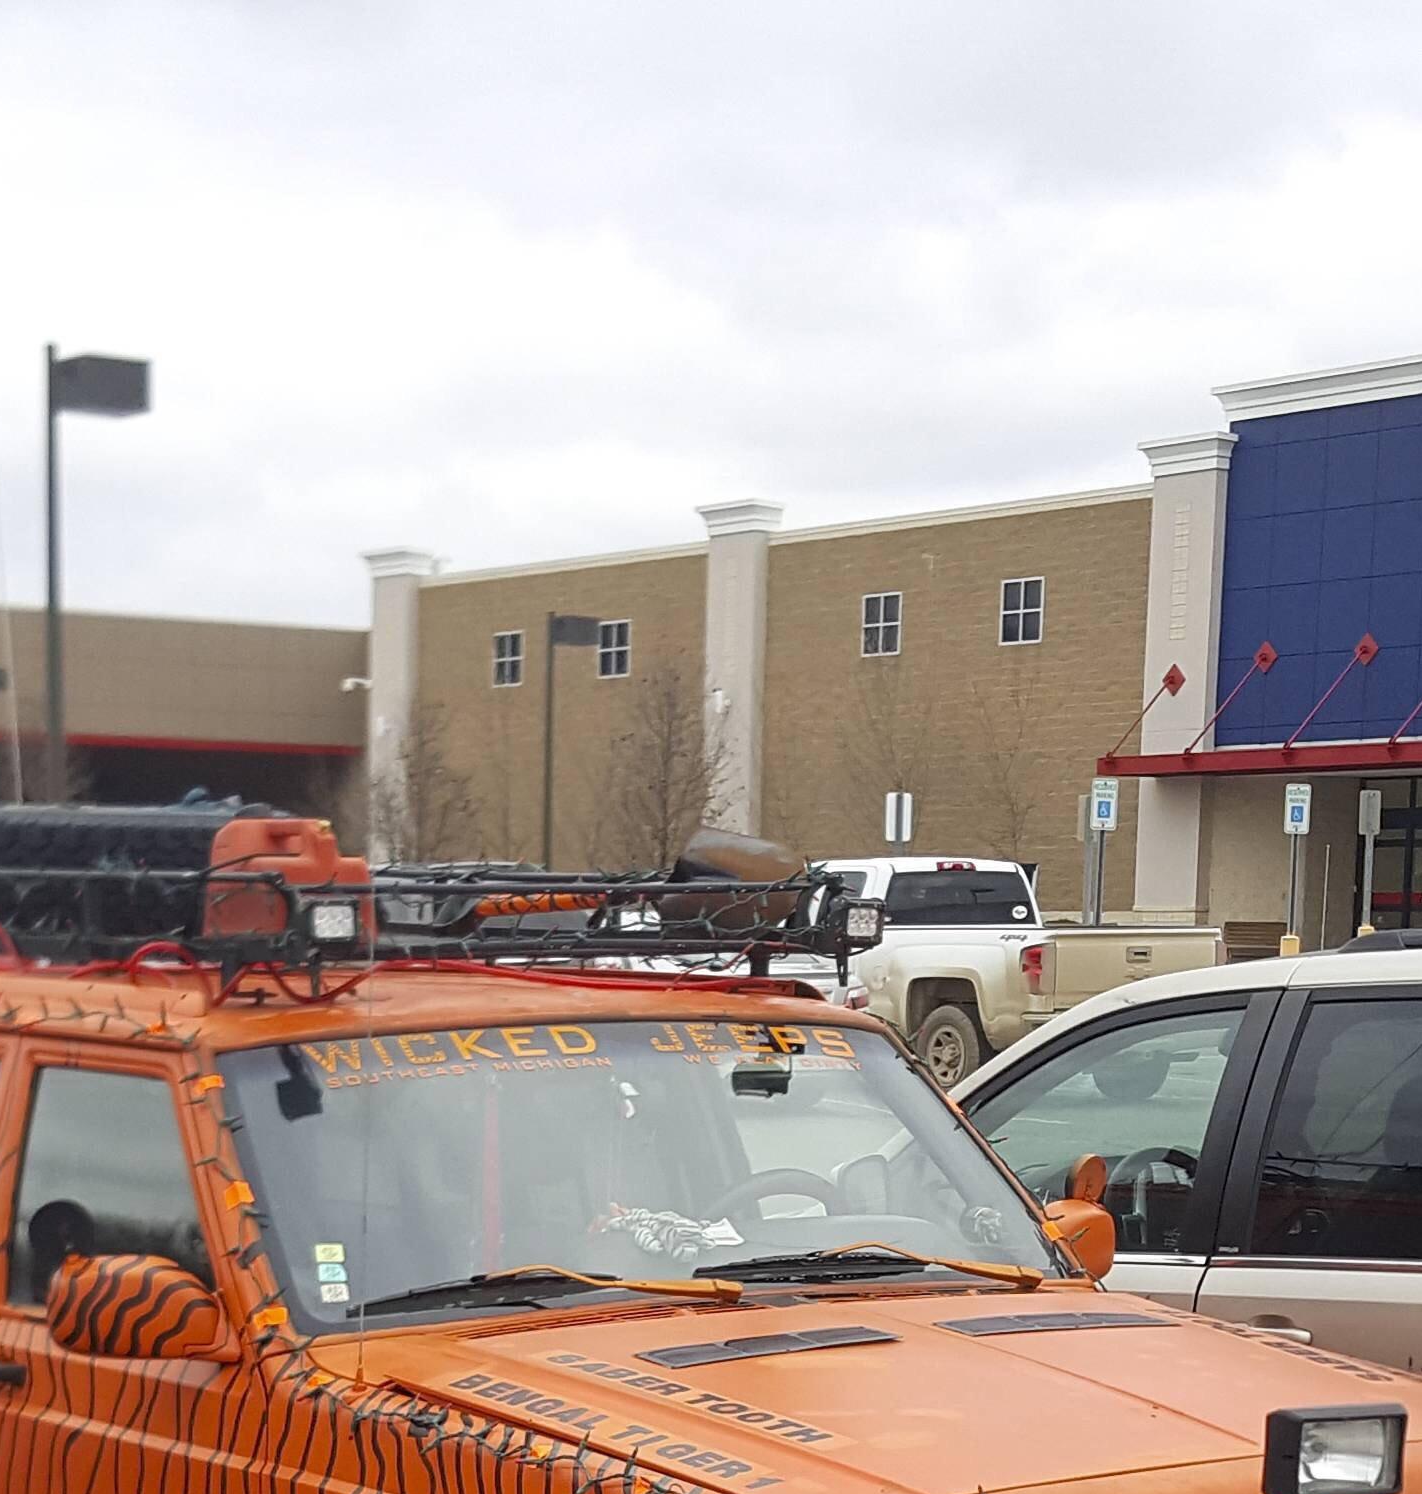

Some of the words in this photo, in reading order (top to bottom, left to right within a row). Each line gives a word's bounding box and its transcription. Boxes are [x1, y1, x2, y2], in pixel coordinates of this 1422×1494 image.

[300, 1024, 598, 1074] WICKED
[650, 1022, 856, 1059] JEEPS
[325, 1062, 481, 1090] SOUTHEAST
[492, 1055, 614, 1073] MICHIGAN
[448, 1373, 610, 1432] BENGAL
[610, 1424, 755, 1479] TIGER
[745, 1475, 784, 1489] 1
[546, 1353, 691, 1397] SABER
[684, 1392, 833, 1445] TOOTH
